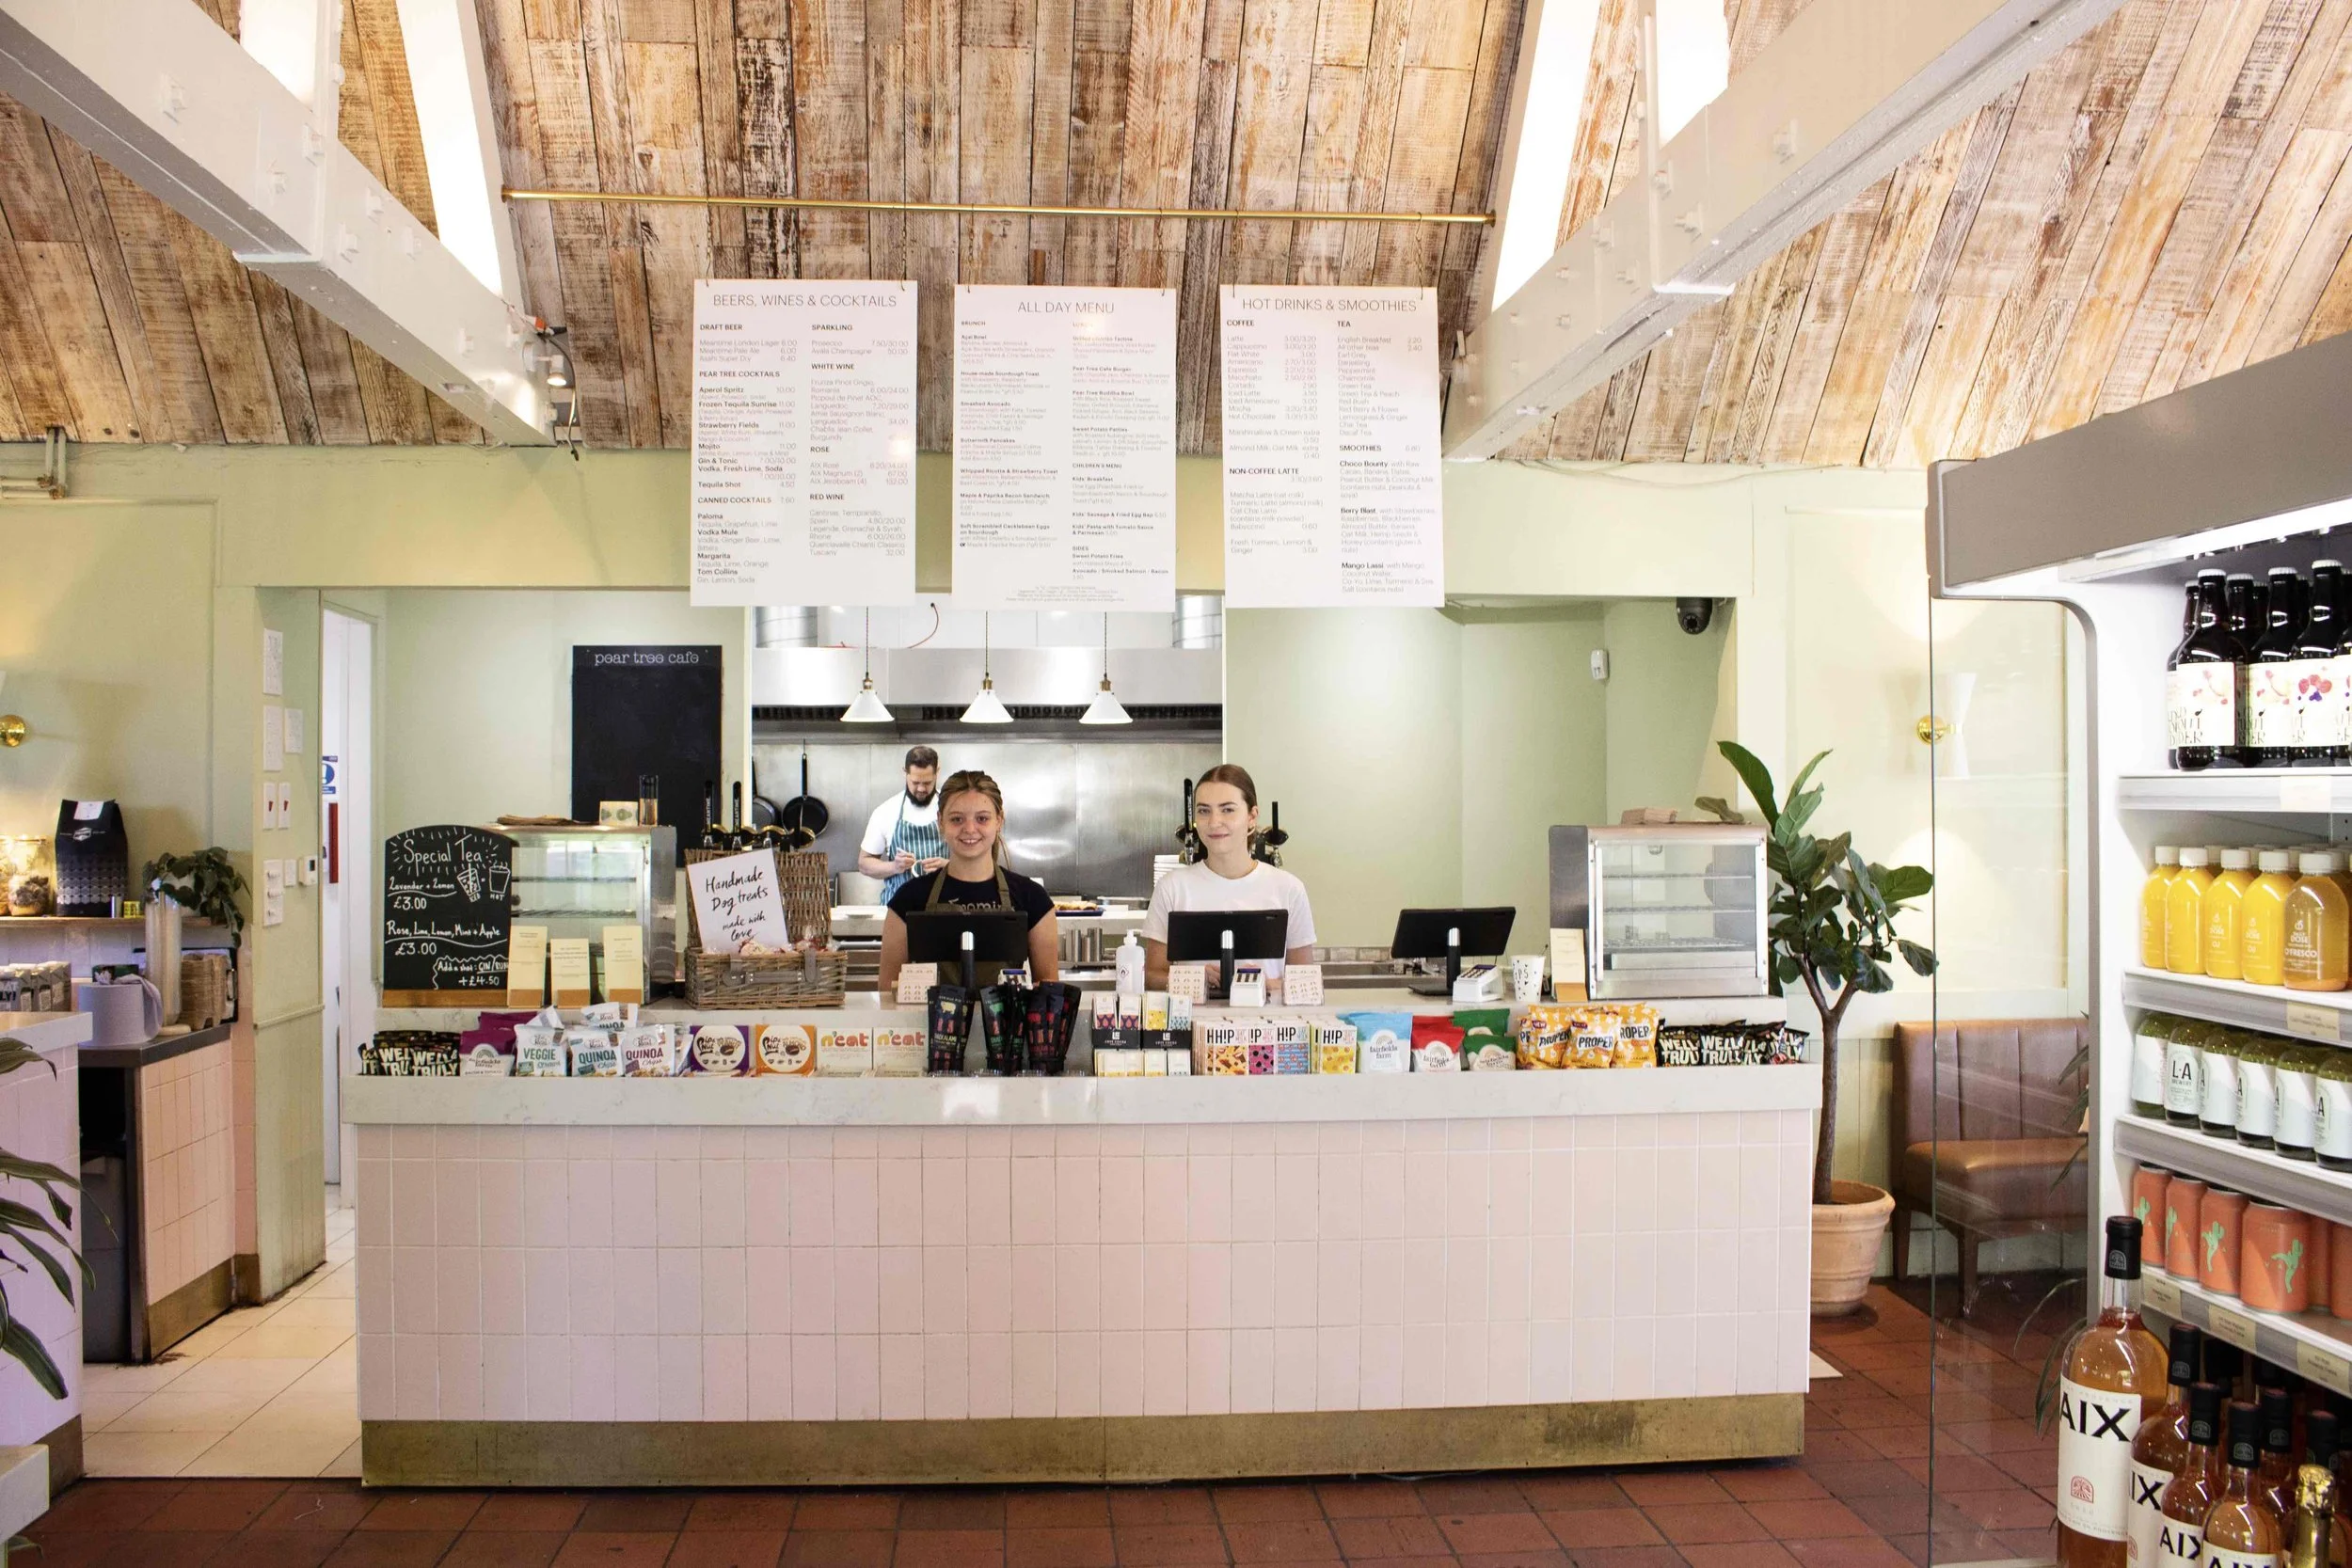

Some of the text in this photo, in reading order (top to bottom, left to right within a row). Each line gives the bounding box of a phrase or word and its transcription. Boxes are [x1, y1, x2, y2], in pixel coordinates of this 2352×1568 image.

[714, 294, 897, 307] BEERS, WINES & COCKTAILS
[1017, 302, 1114, 314] ALL DAY MENU
[1242, 298, 1417, 312] HOT DRINKS & SMOOTHIES
[595, 651, 699, 666] pear tree cafe
[403, 838, 452, 877] Special
[389, 876, 423, 891] Lavender
[433, 878, 455, 890] Lemon
[706, 866, 763, 893] Handmade
[393, 896, 427, 911] £3.00
[712, 886, 769, 916] Dog treats
[723, 911, 766, 931] made with
[386, 920, 412, 937] Rose,
[455, 923, 471, 936] Mint
[479, 924, 501, 939] Apple
[395, 942, 437, 956] £3.00
[437, 961, 453, 971] Add
[1277, 1027, 1296, 1042] H!P
[1323, 1029, 1343, 1044] H!P
[1620, 1026, 1650, 1039] ROPER
[1578, 1035, 1613, 1048] PROPER
[1701, 1035, 1743, 1051] WELL
[379, 1048, 412, 1063] WEL
[414, 1051, 451, 1066] WELL
[523, 1047, 557, 1061] VEGGIE
[579, 1050, 617, 1064] QUINOA
[626, 1047, 664, 1061] QUINOA
[412, 1062, 458, 1077] TRULY
[2060, 1391, 2132, 1443] AIX
[2131, 1471, 2164, 1511] IX
